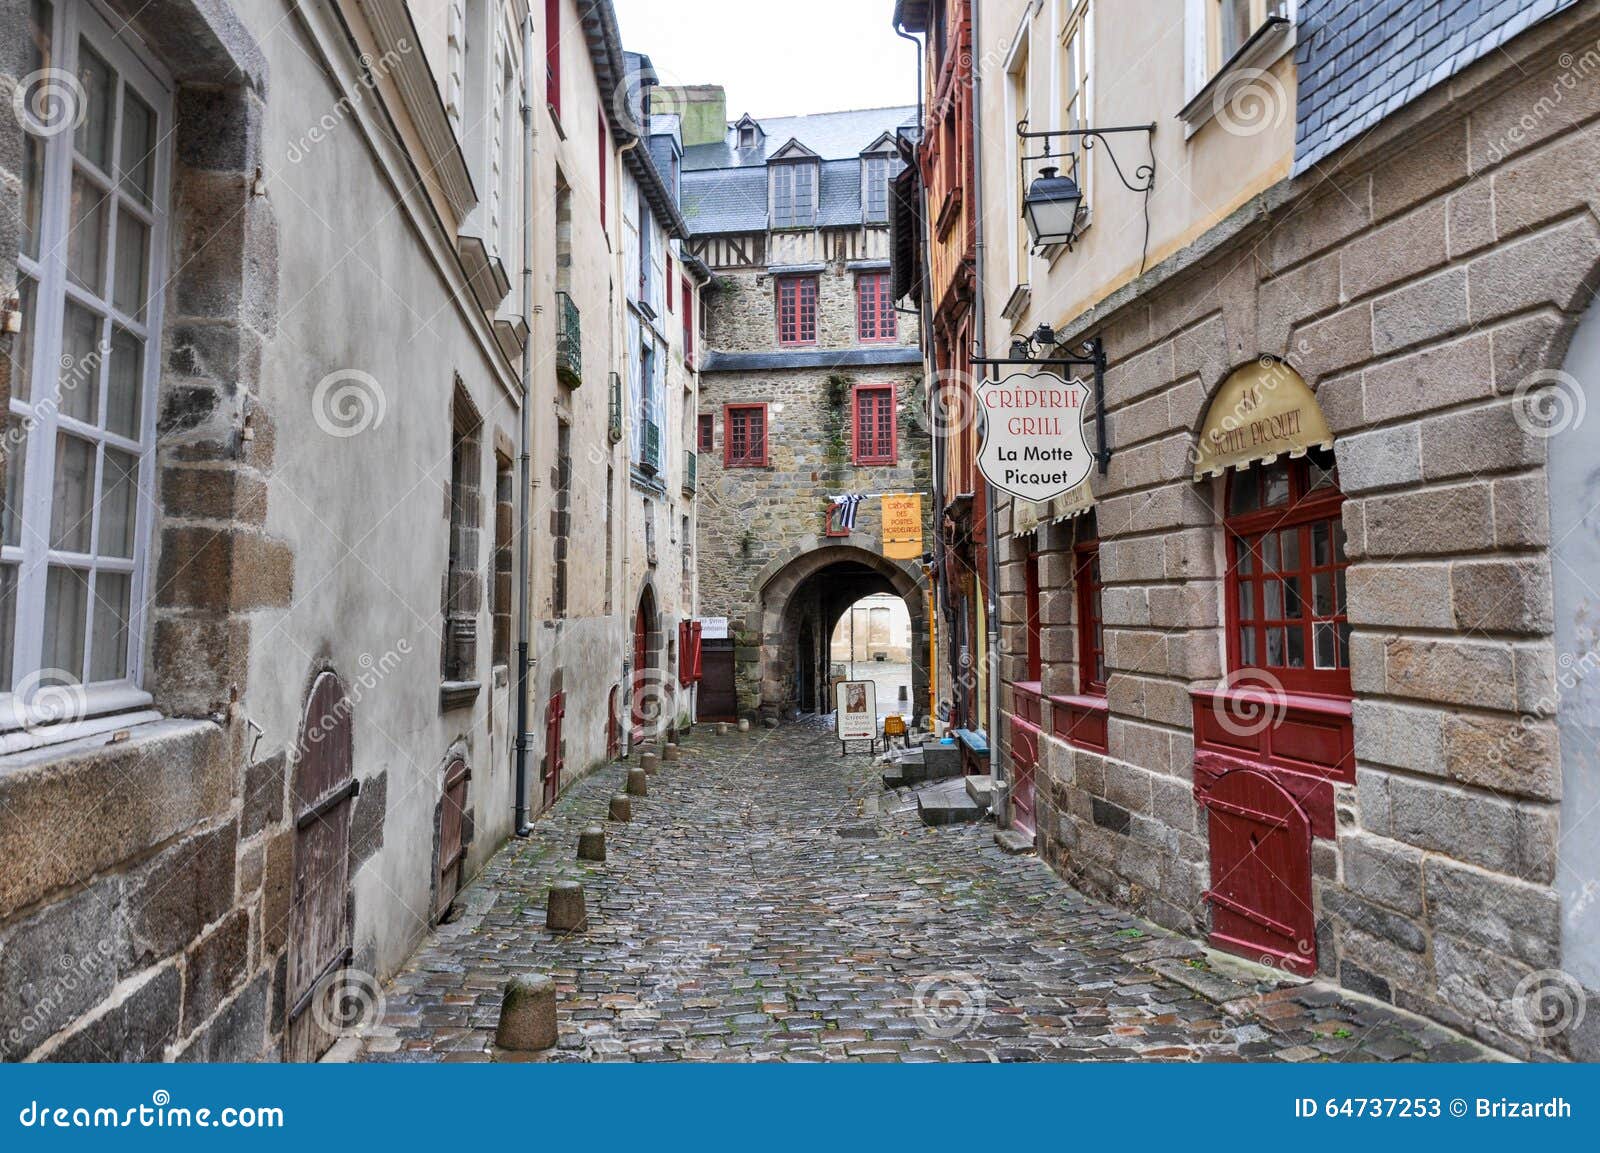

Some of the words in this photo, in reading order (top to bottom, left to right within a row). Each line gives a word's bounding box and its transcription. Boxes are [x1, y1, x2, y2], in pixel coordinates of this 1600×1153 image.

[985, 385, 1080, 409] CRÊPERIE
[1007, 417, 1063, 435] GRILL
[1250, 408, 1302, 446] PICQUET
[998, 446, 1017, 461] La
[1023, 446, 1073, 461] Motte
[1005, 468, 1069, 485] Picquet
